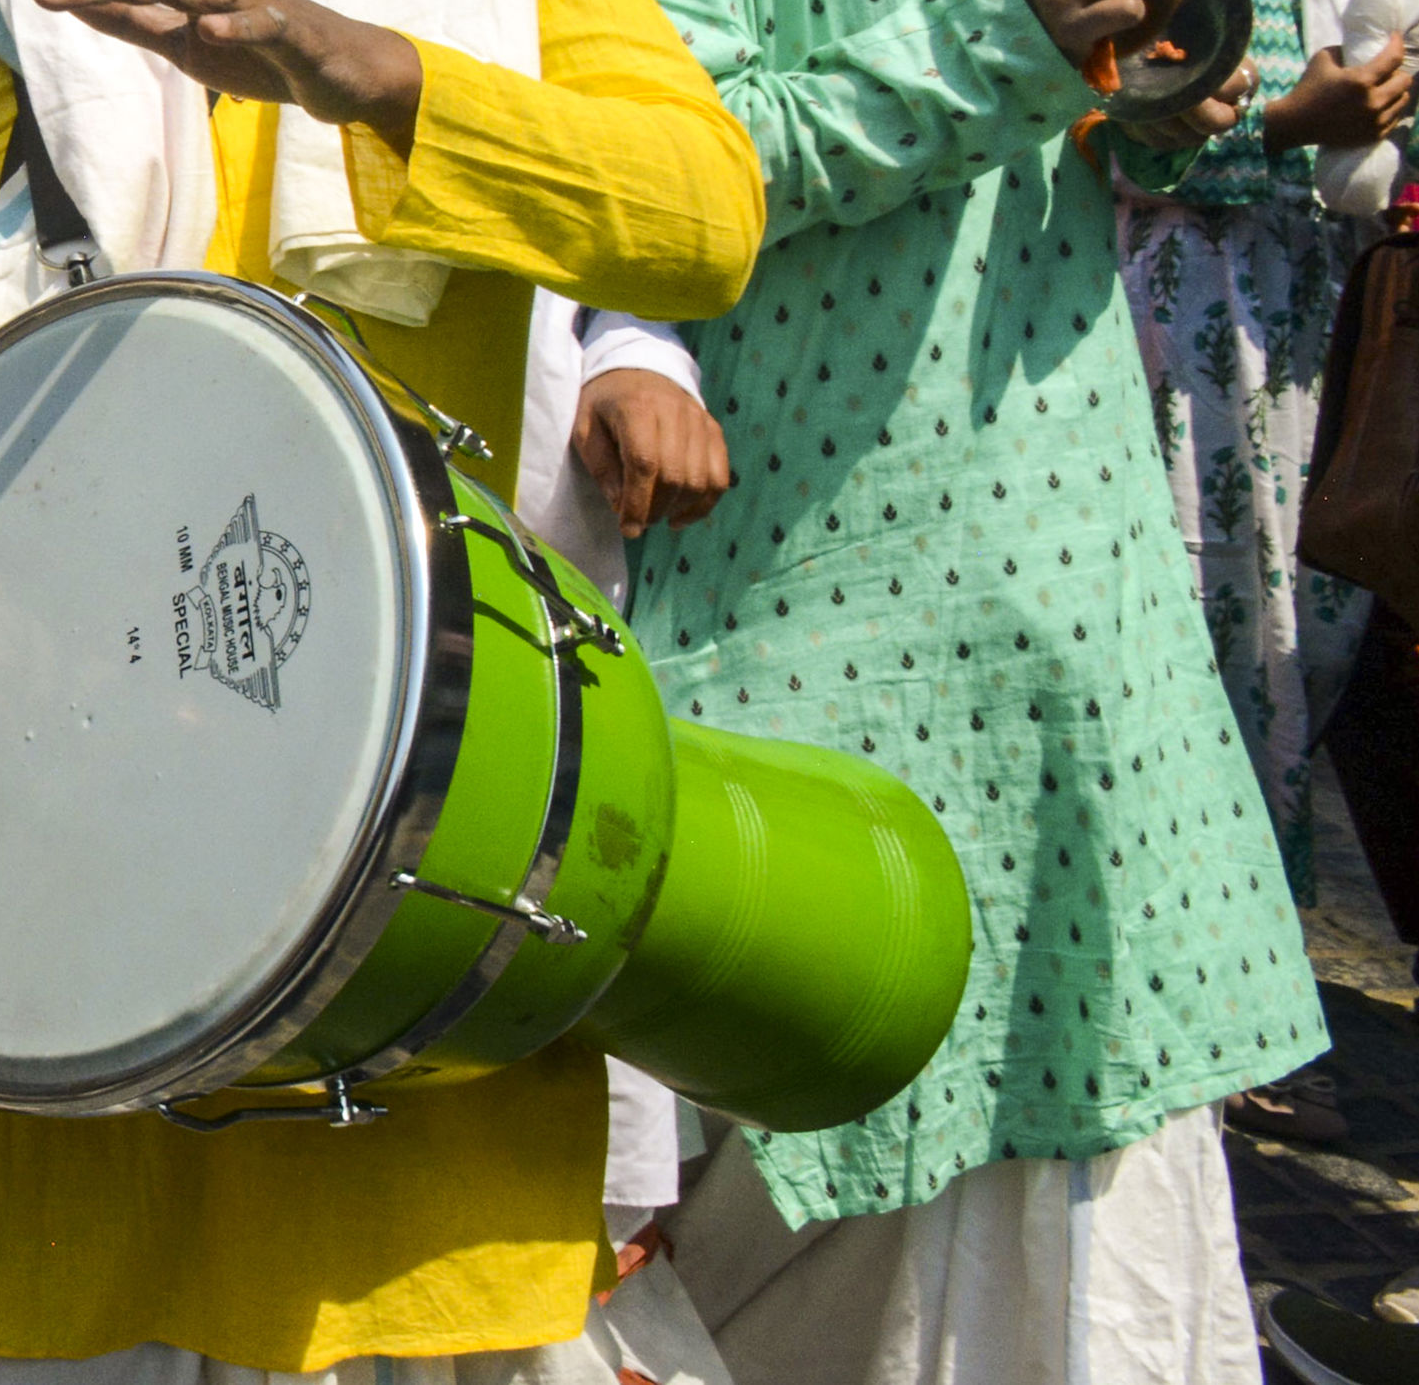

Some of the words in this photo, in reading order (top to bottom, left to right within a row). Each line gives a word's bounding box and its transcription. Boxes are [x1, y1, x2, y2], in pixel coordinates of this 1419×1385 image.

[175, 525, 189, 543] 10
[178, 545, 193, 573] MM
[216, 562, 231, 605] BENGAL
[202, 600, 215, 650] KOLKATA
[220, 605, 234, 638] MUSIC
[234, 560, 256, 662] बंगाल
[172, 592, 192, 679] SPECIAL
[225, 638, 240, 675] HOUSE
